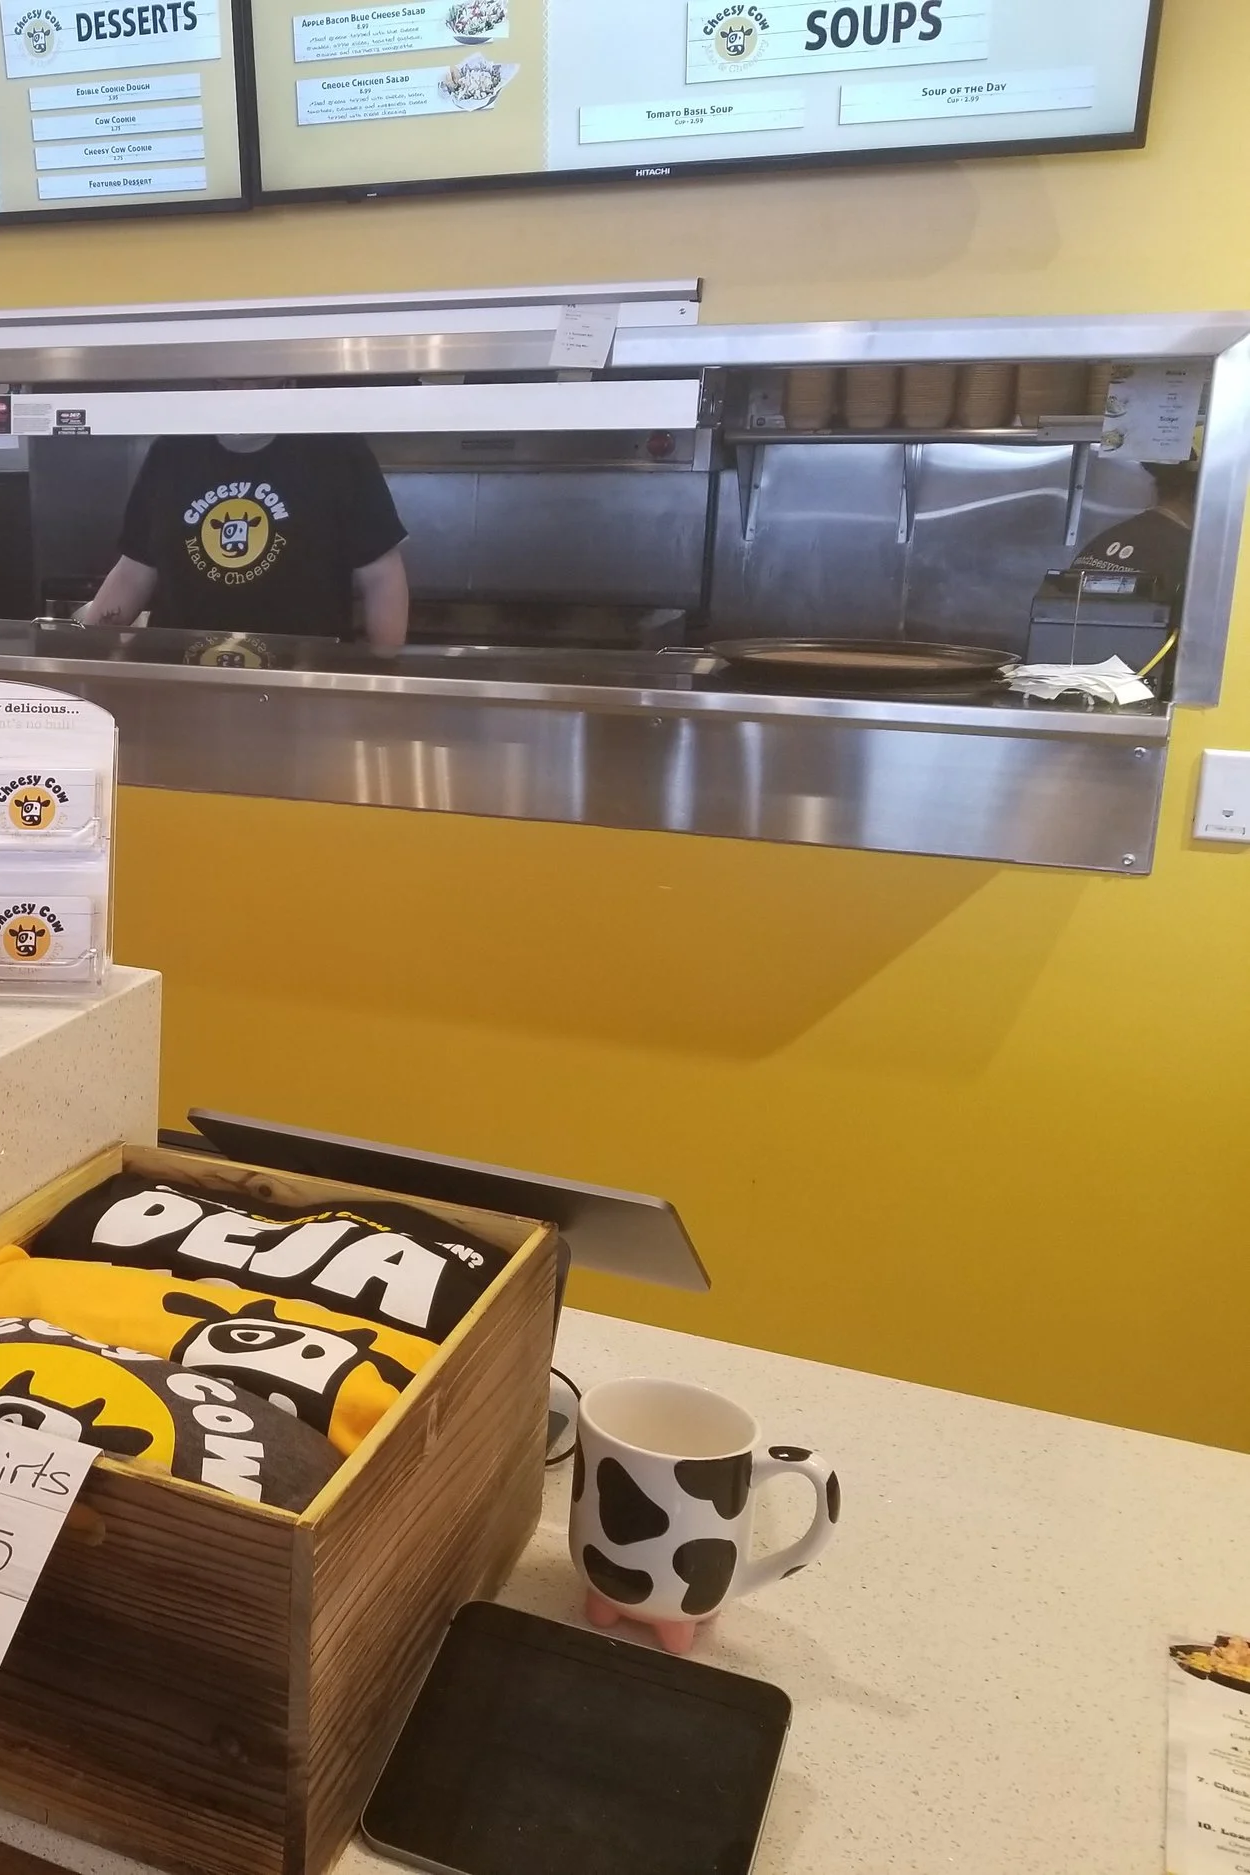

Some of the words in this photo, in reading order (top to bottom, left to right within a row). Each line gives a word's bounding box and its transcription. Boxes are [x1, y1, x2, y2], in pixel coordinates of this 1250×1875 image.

[14, 9, 42, 36] Cheesy
[45, 9, 62, 32] Cow
[75, 1, 198, 42] DESSERTS
[703, 4, 744, 36] Cheesy
[747, 5, 770, 31] Cow
[804, 0, 942, 51] SOUPS
[690, 117, 704, 125] 2.99
[635, 167, 670, 177] HITACHI
[183, 482, 251, 525] Cheesy
[254, 482, 289, 521] Cow
[185, 536, 207, 571] Mac
[207, 567, 221, 582] &
[224, 531, 287, 585] Cheesery
[44, 777, 69, 804] Cow
[39, 905, 64, 933] Cow
[93, 1190, 448, 1329] DEJA
